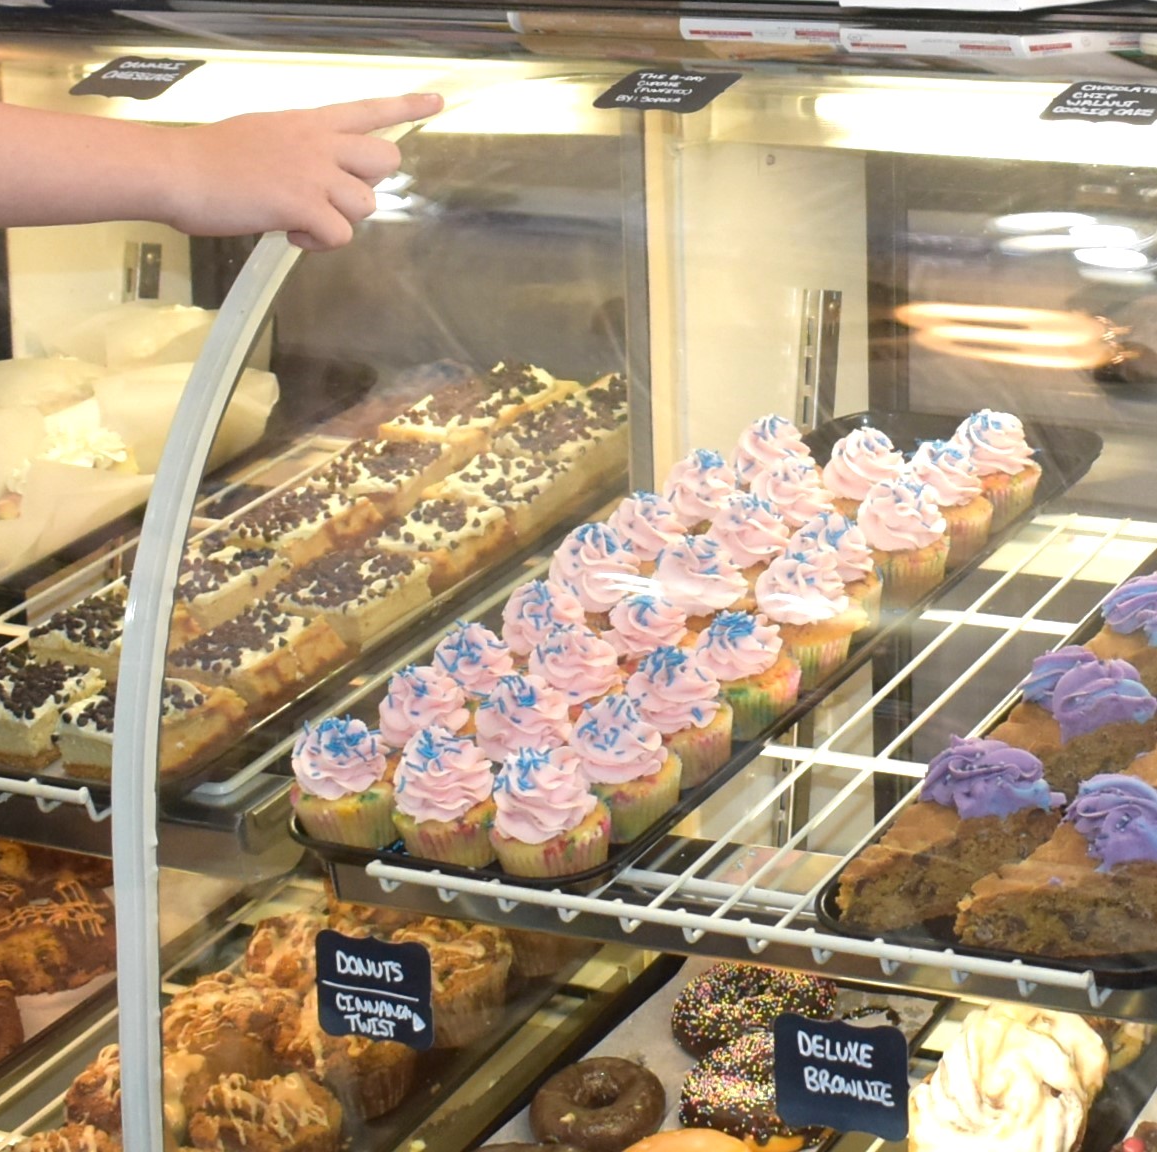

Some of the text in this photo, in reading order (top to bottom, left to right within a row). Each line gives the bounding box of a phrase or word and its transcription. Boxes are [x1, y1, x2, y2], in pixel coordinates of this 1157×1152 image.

[335, 949, 404, 982] DONUTS
[343, 1013, 396, 1038] TWIST
[797, 1029, 874, 1069] DELUXE
[803, 1065, 895, 1107] BROWNIE
